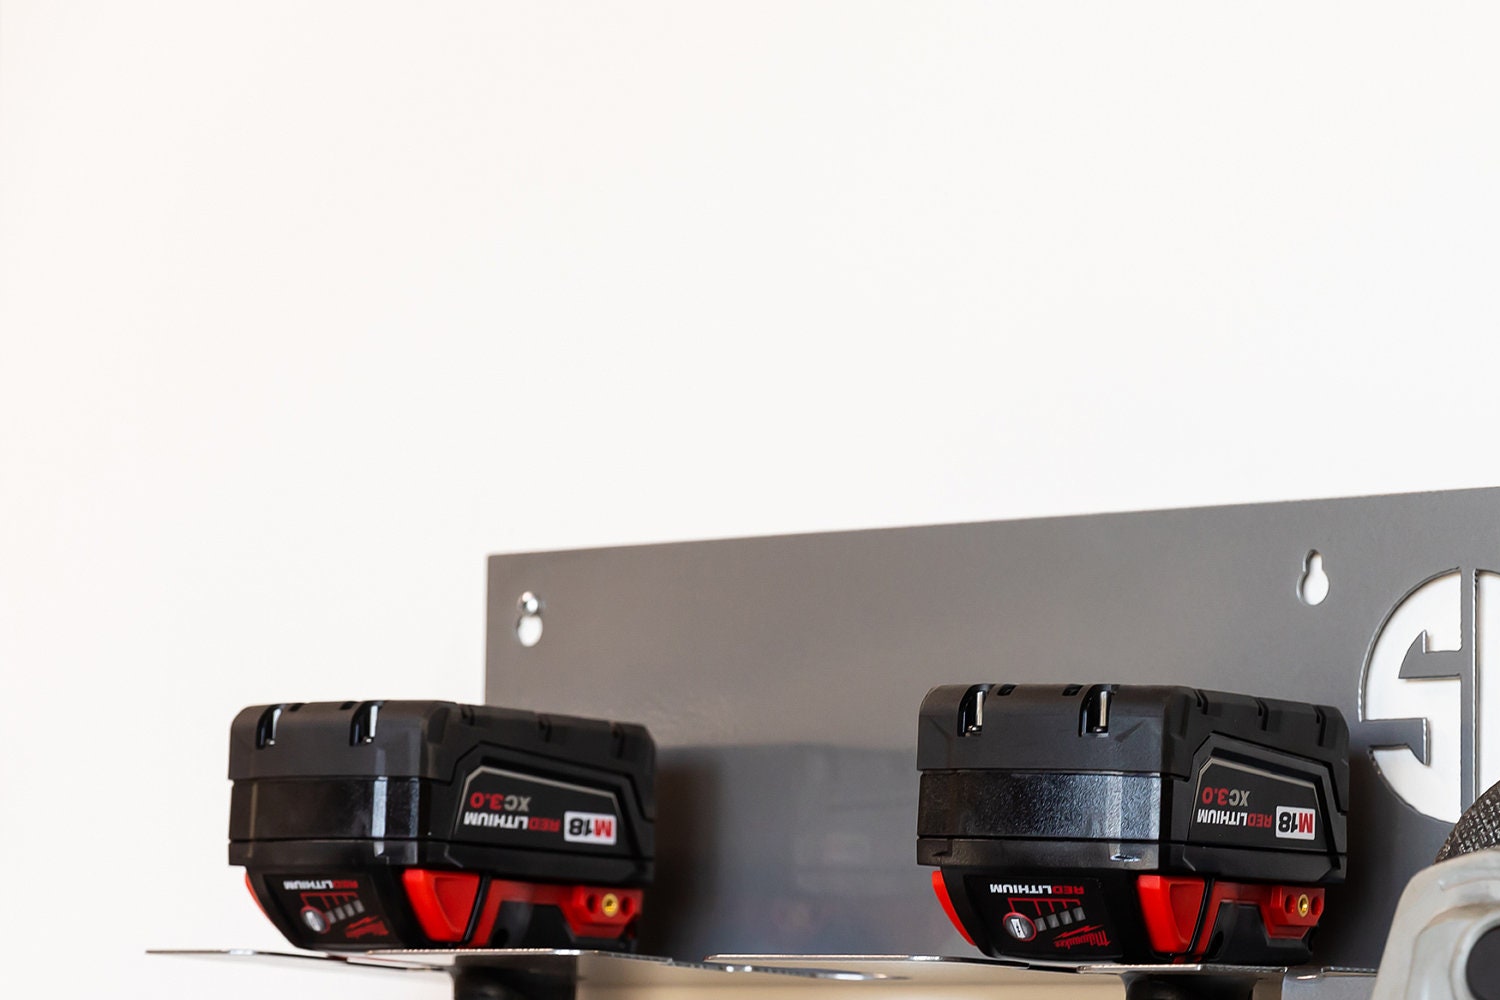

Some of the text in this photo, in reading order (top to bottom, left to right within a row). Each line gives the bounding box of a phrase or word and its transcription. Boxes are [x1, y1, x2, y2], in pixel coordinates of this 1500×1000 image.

[470, 791, 531, 813] XC3.0
[1201, 786, 1251, 807] XC3.0
[569, 817, 613, 841] M18
[1196, 808, 1314, 835] M18 REDLITHIUM
[989, 883, 1085, 896] REDLITHIUM
